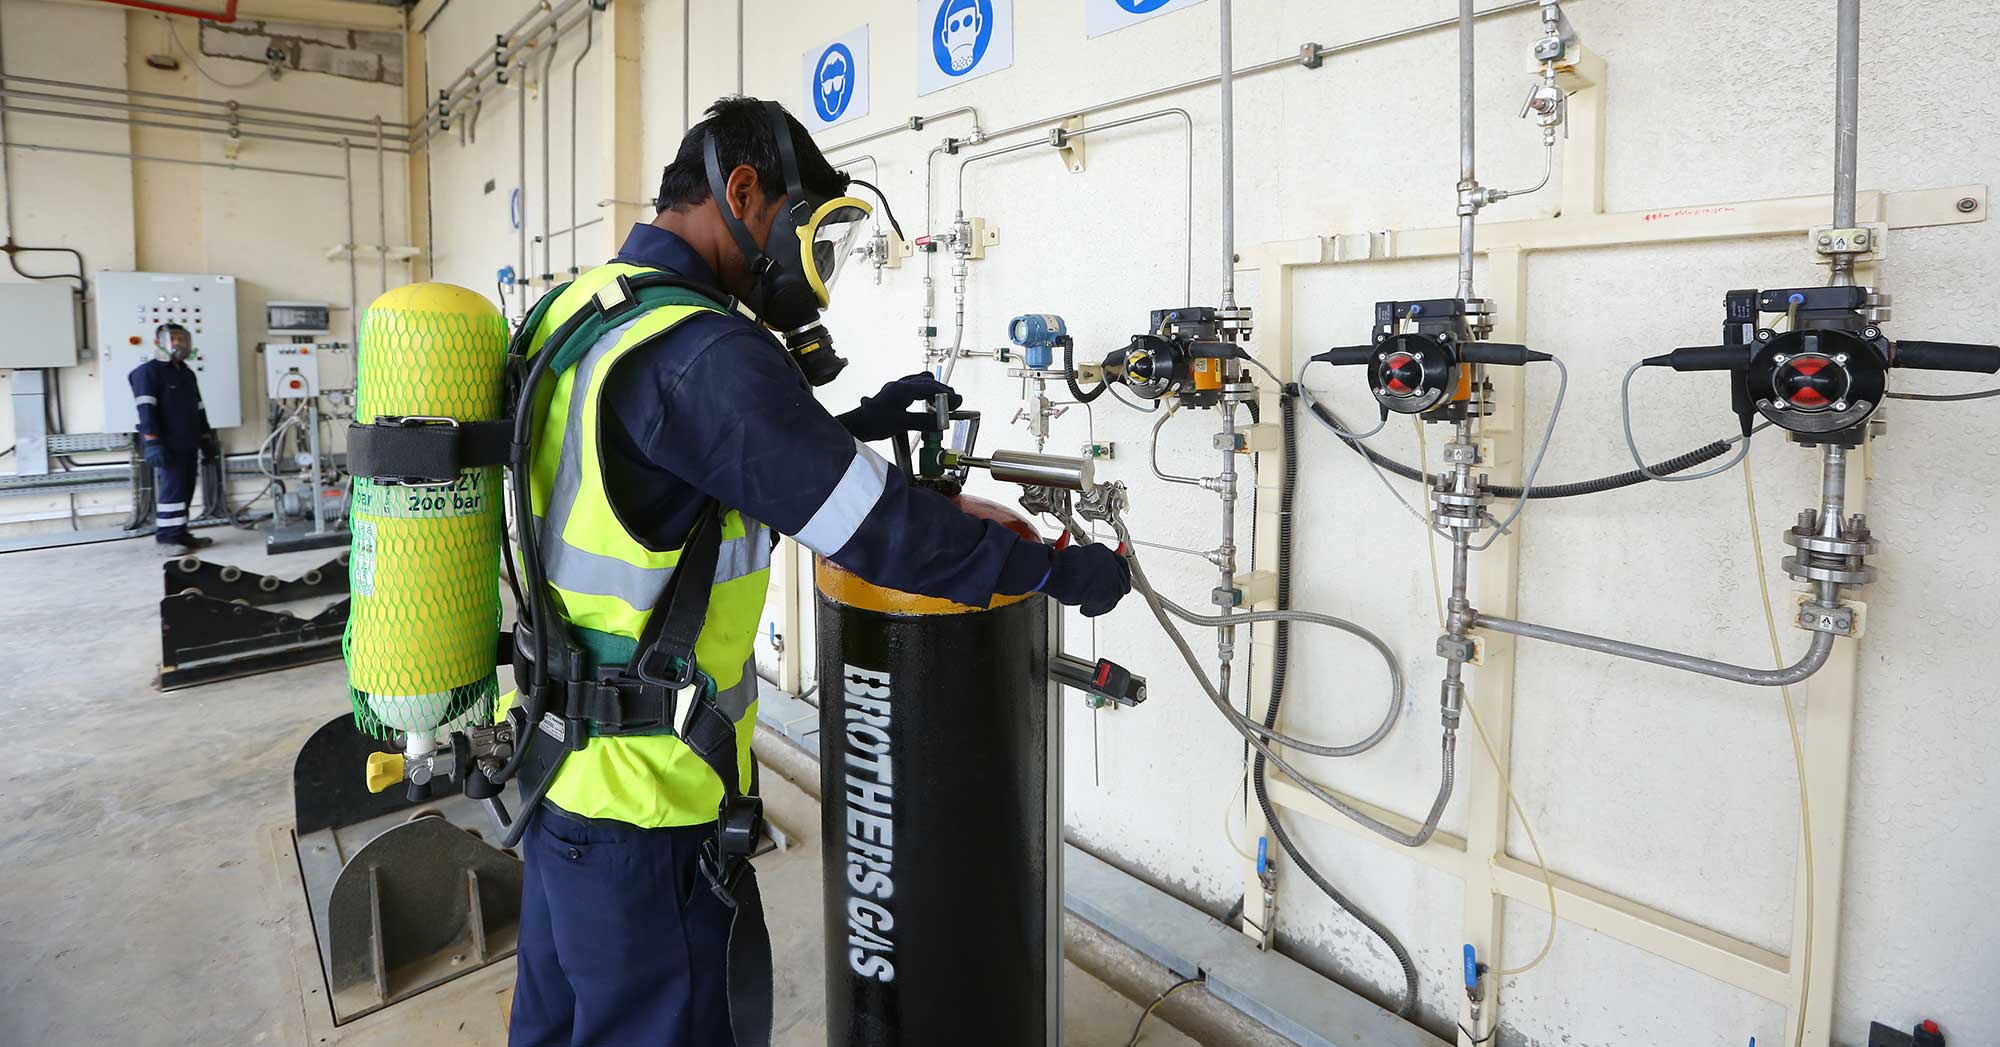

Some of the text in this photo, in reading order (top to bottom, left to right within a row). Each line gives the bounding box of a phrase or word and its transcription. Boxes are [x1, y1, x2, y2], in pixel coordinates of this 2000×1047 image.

[408, 496, 446, 511] 200
[453, 493, 481, 510] bar
[844, 663, 895, 983] BROTHERS GAS
